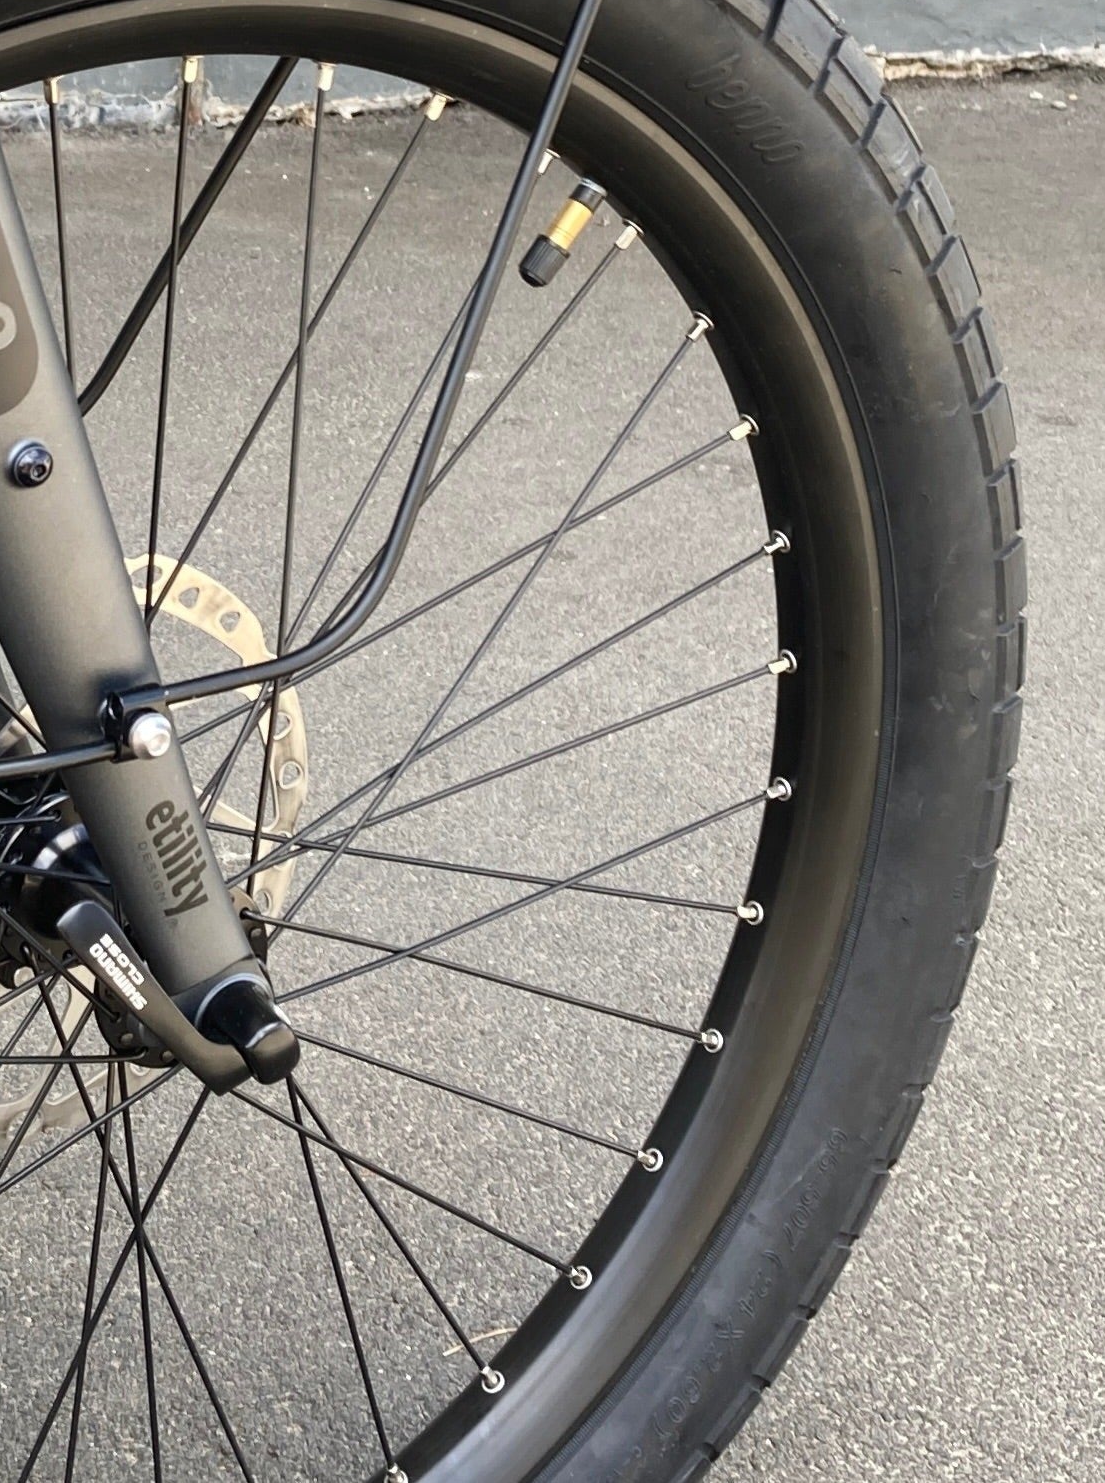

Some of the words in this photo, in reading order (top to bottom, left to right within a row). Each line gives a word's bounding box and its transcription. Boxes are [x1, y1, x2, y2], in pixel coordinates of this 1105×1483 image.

[686, 52, 806, 165] benno
[138, 841, 167, 902] DESIGN
[146, 800, 209, 917] etility
[89, 943, 147, 1010] SHIMANO
[100, 933, 144, 985] CLOSE
